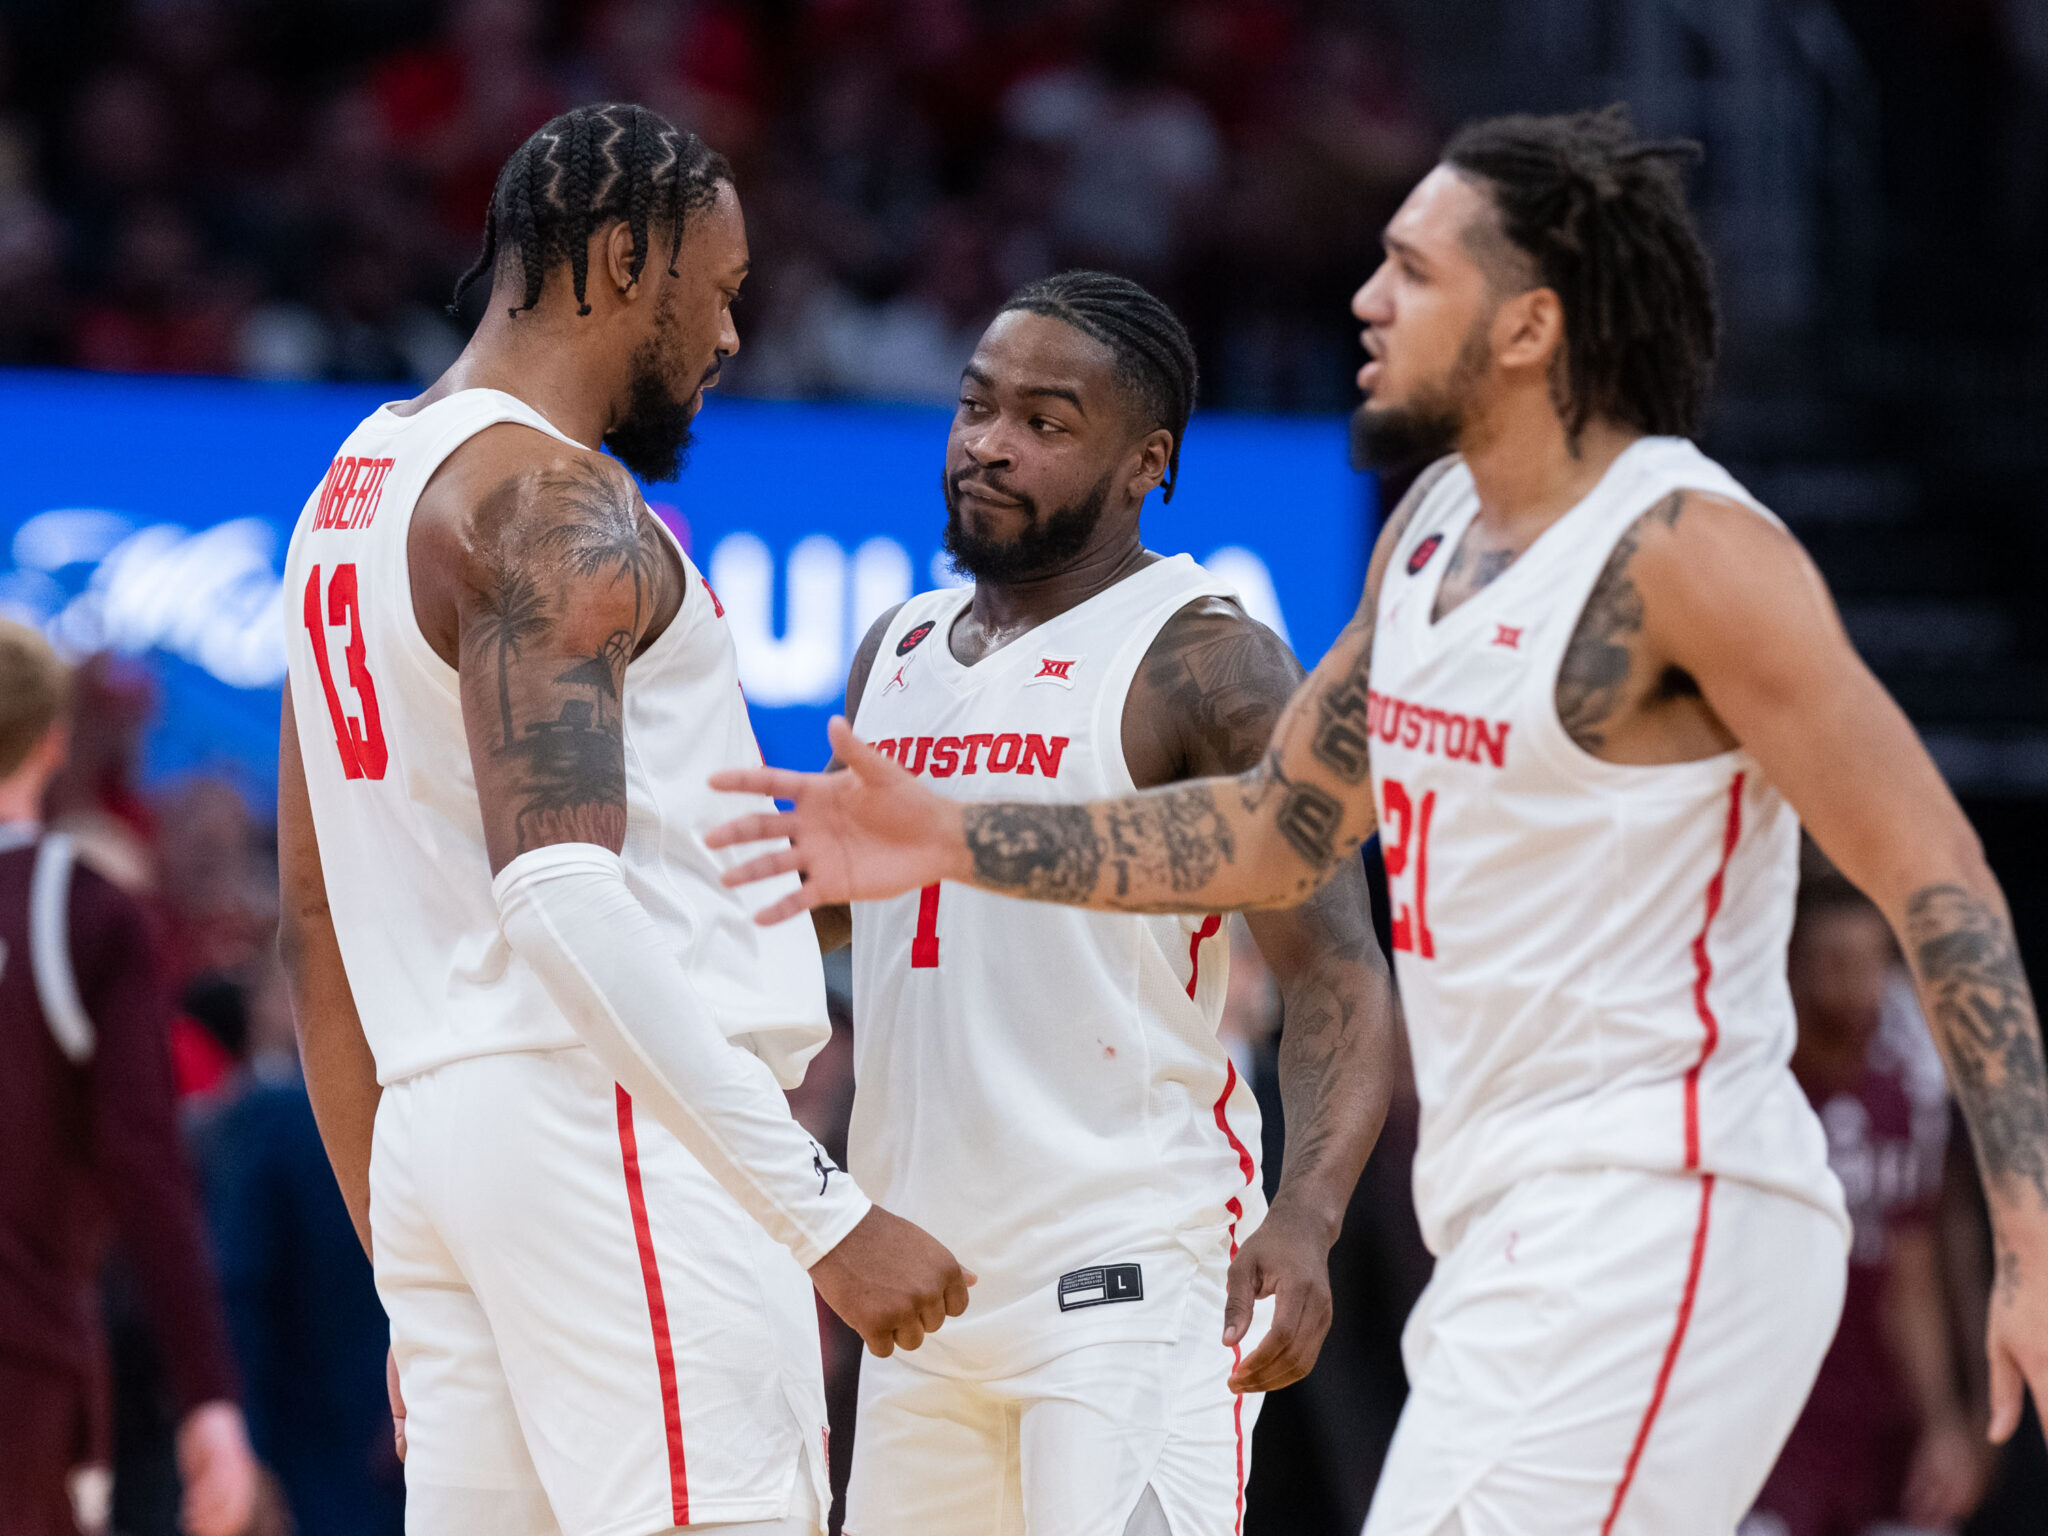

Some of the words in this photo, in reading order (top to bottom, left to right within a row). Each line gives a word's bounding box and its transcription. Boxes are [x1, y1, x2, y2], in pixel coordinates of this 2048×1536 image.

[304, 563, 388, 780] 13
[1383, 778, 1437, 960] 21
[1117, 1275, 1127, 1289] L
